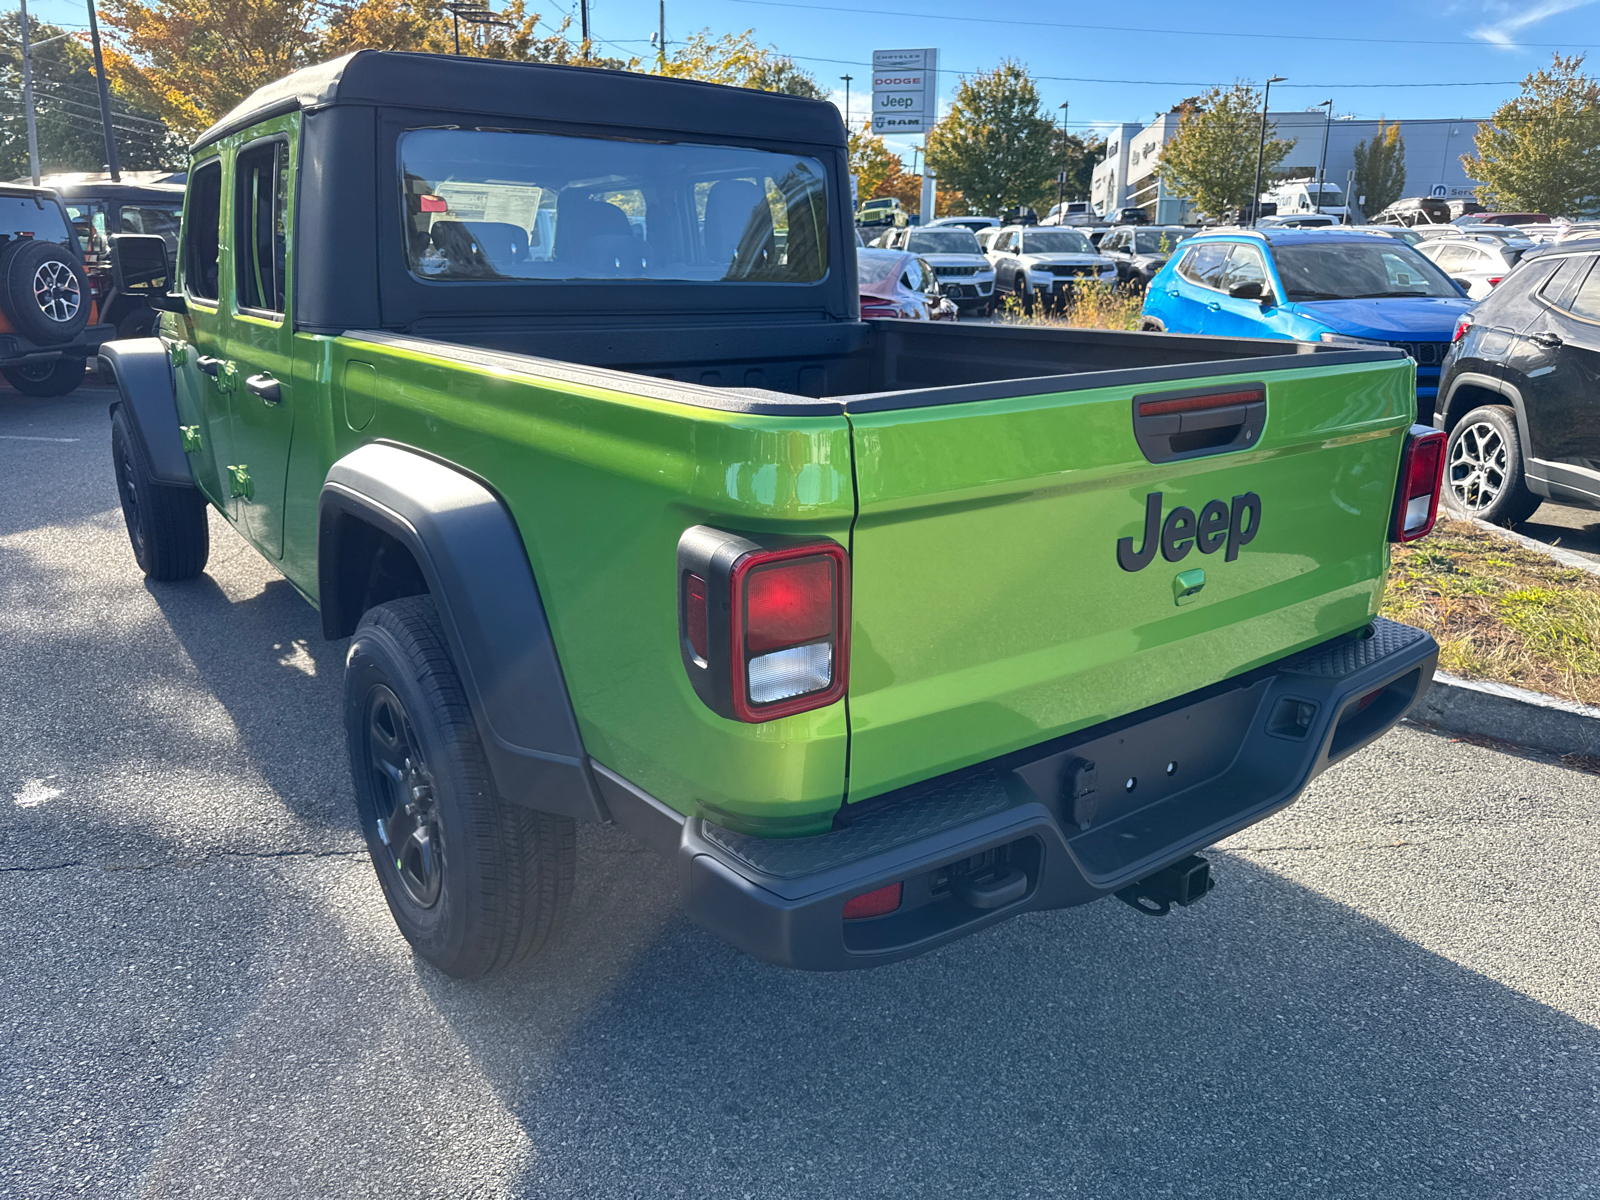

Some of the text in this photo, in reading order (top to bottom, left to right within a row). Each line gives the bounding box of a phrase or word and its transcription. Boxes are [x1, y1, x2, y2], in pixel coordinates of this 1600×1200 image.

[881, 95, 913, 109] Jeep
[1451, 188, 1474, 196] Serv
[1116, 491, 1262, 573] Jeep
